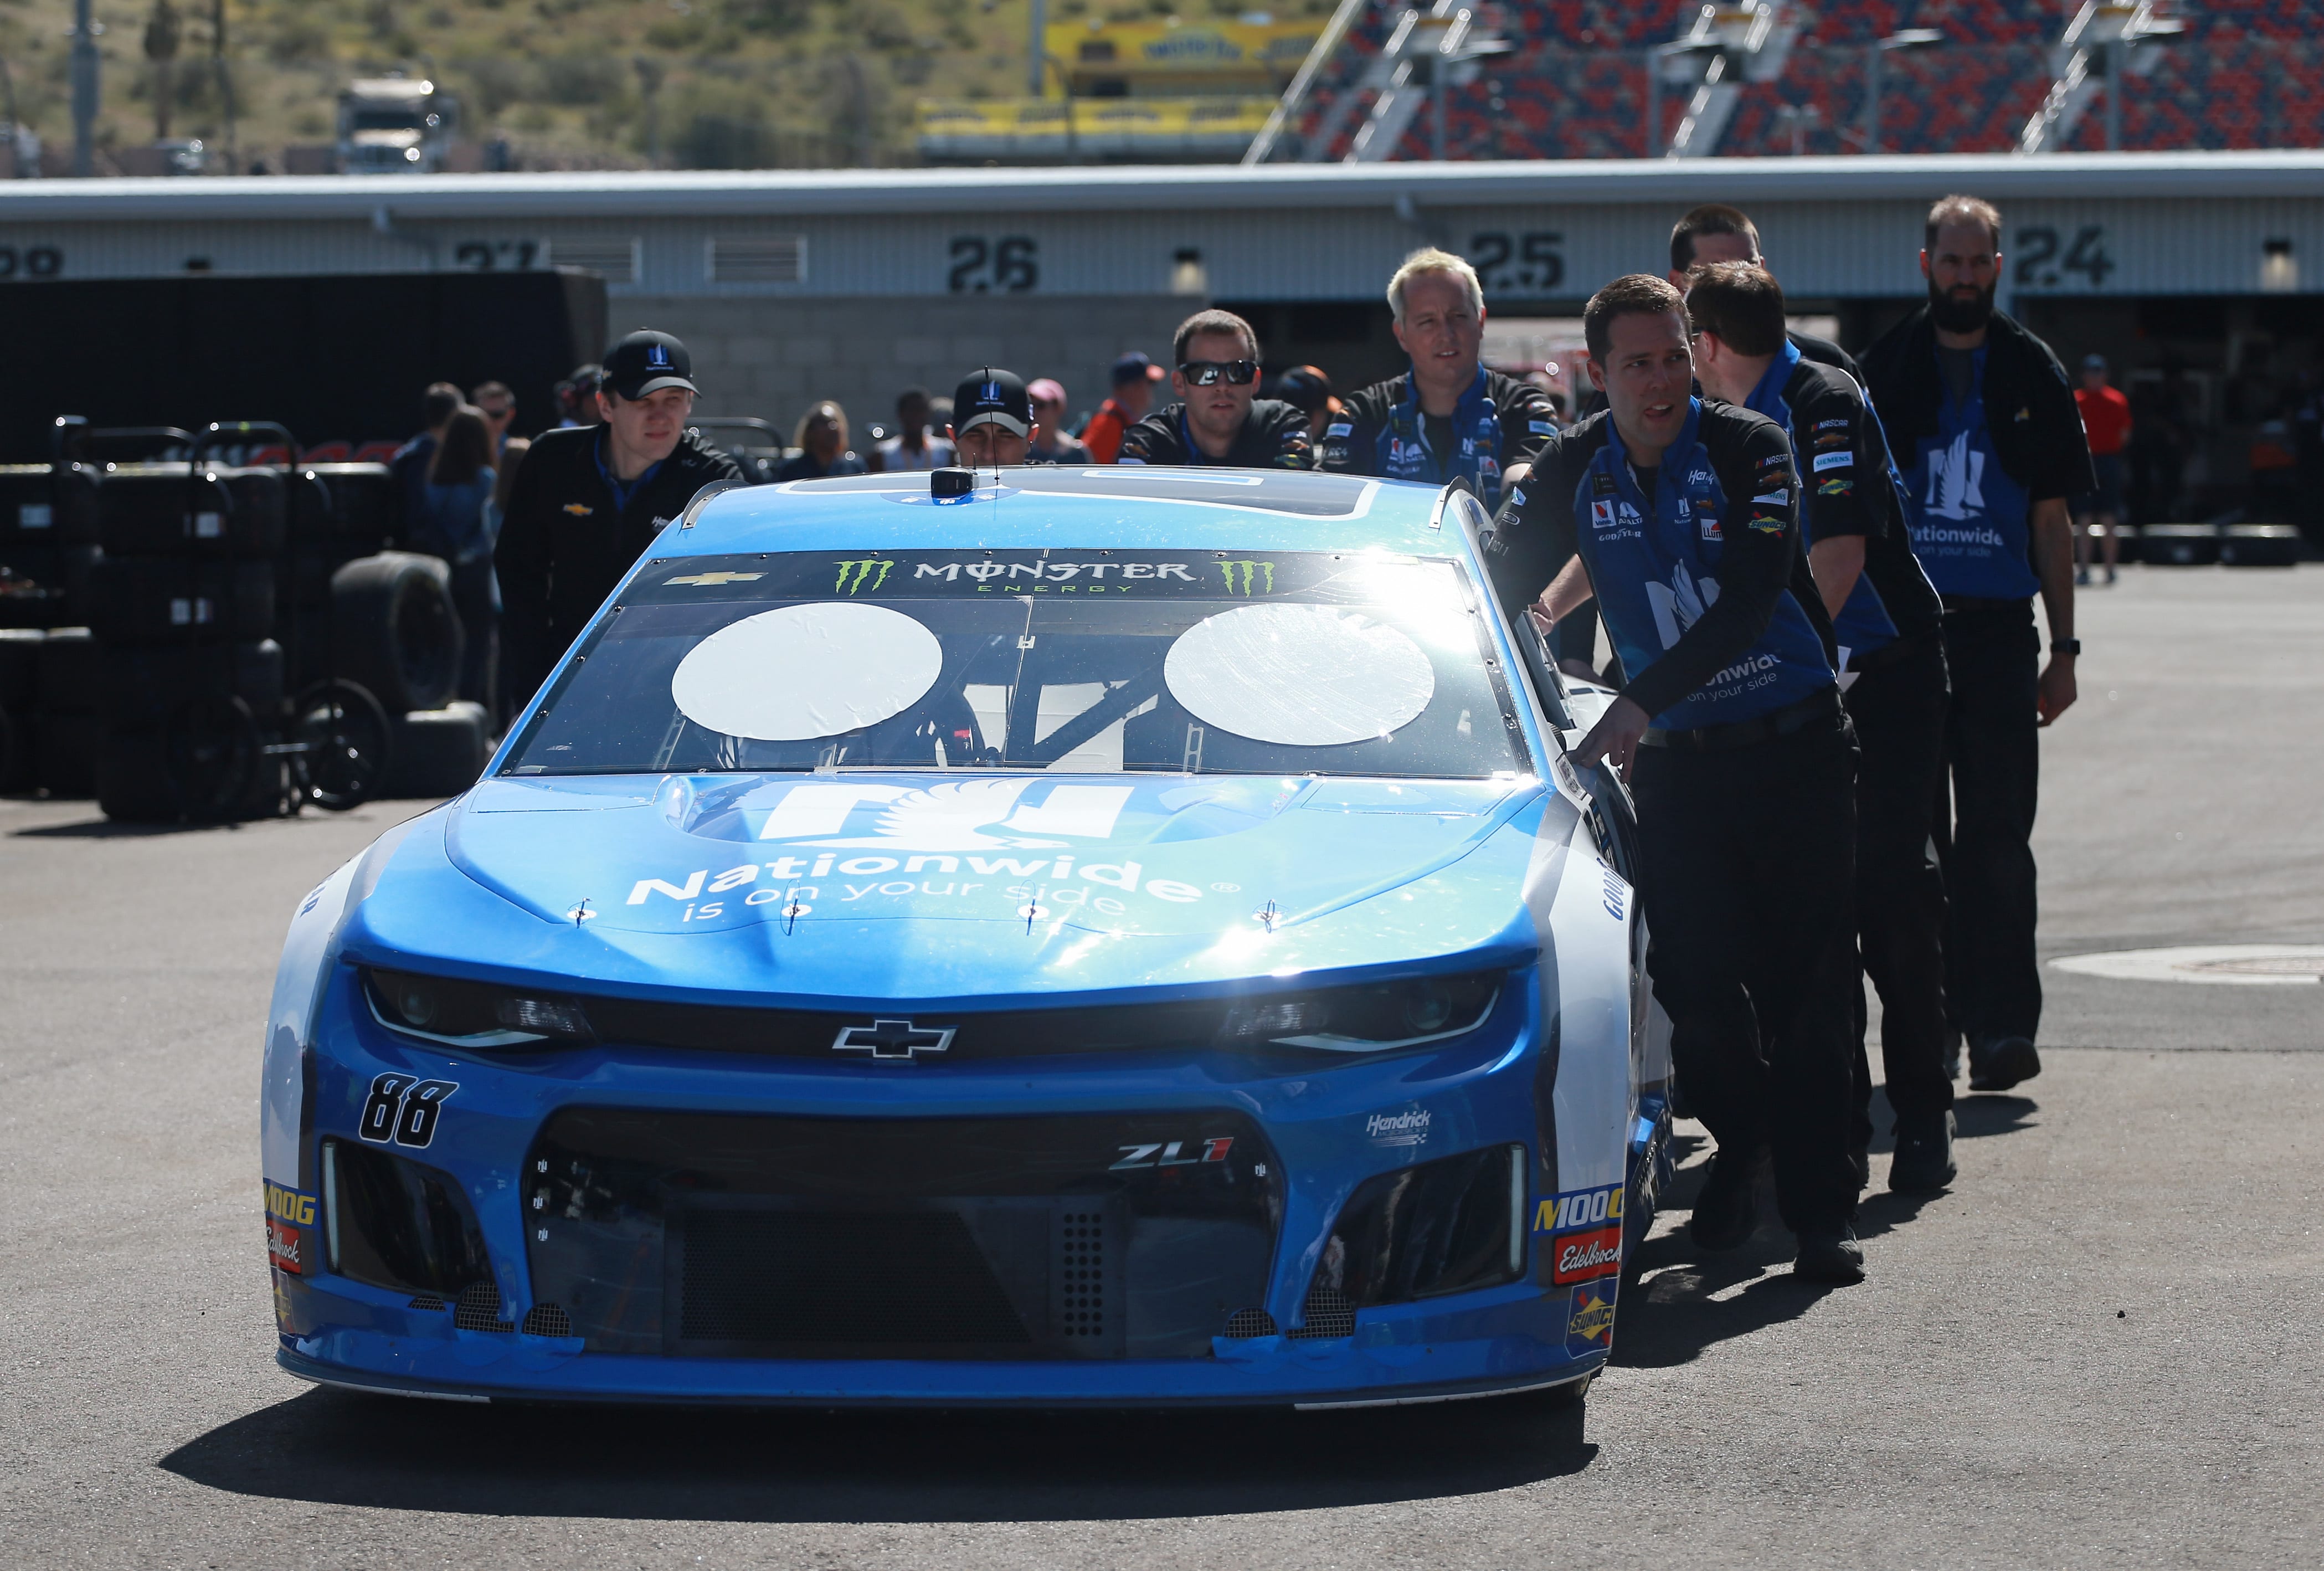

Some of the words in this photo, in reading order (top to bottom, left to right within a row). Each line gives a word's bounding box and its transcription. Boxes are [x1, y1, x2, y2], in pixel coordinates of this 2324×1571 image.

[948, 237, 1039, 292] 26
[1471, 232, 1565, 289] 25
[2013, 225, 2116, 287] 24
[1819, 419, 1848, 429] NASCAR
[1765, 454, 1790, 466] NASCAR
[1816, 455, 1850, 466] SIEMENS
[1749, 519, 1787, 531] SUNOCO
[1910, 525, 2004, 546] ationwide
[913, 559, 1197, 582] MONSTER
[977, 584, 1133, 593] ENERGY
[1709, 684, 1743, 702] your
[1747, 672, 1778, 691] side
[682, 902, 724, 922] is
[744, 885, 819, 906] on
[840, 881, 984, 902] your
[1002, 881, 1127, 915] side
[358, 1071, 460, 1149] 88
[1365, 1110, 1432, 1137] Hendrick
[1108, 1137, 1235, 1170] ZL1
[1570, 1305, 1615, 1334] SUNOC
